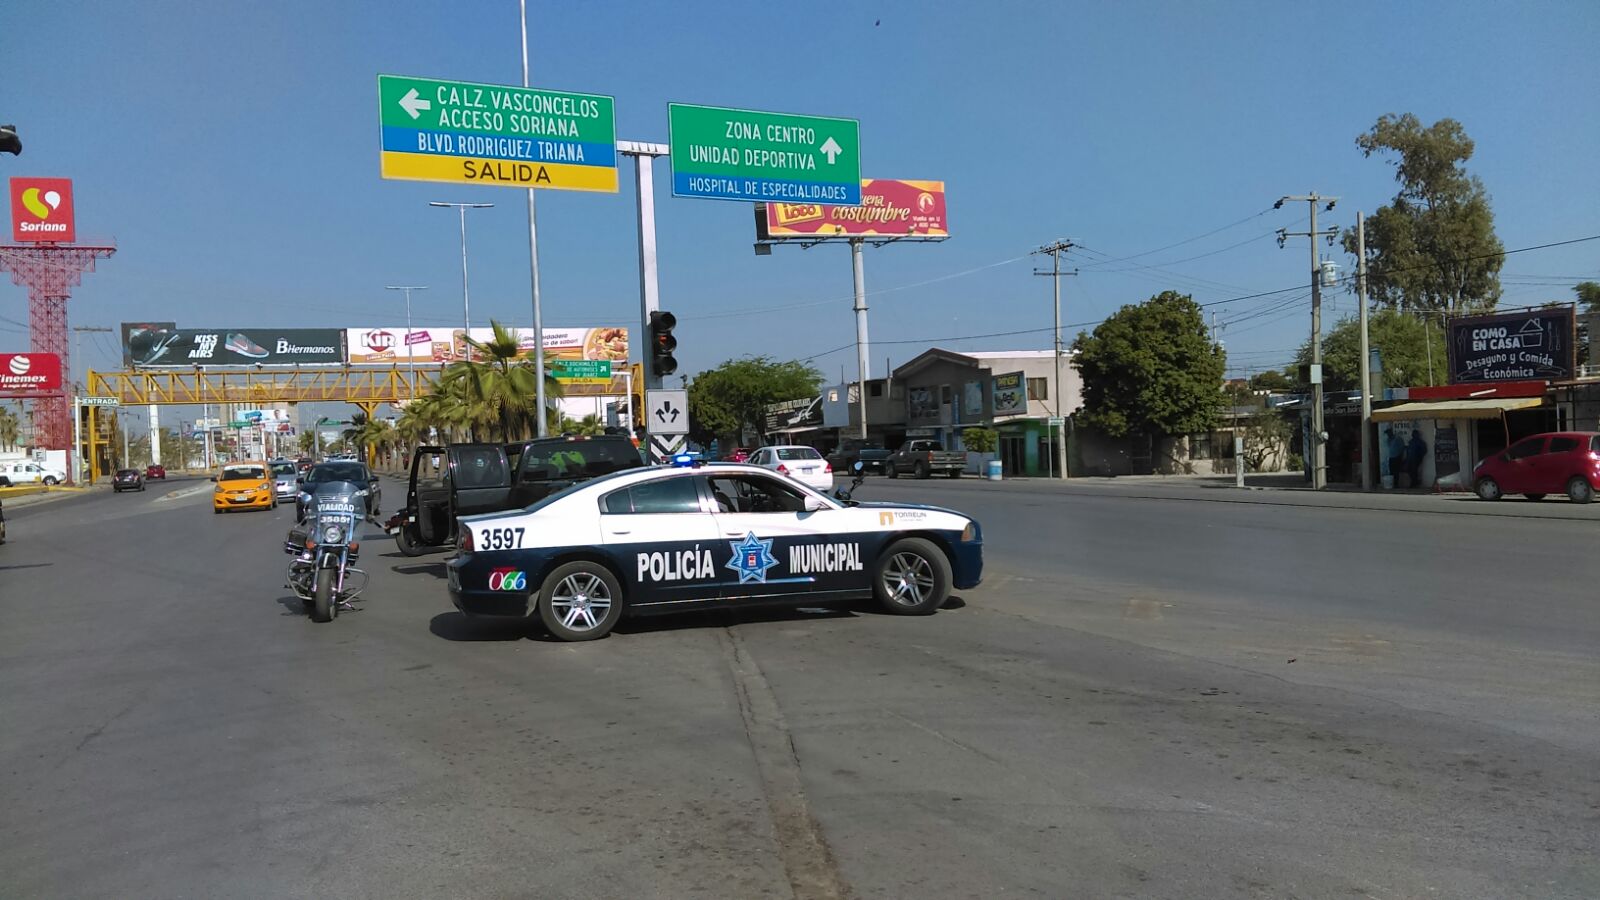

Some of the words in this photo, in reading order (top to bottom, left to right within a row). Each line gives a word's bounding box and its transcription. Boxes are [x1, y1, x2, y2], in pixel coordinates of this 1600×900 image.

[437, 86, 487, 109] CALZ.
[491, 91, 599, 118] VASCONCELOS
[438, 109, 503, 132] ACCESO
[510, 115, 579, 137] SORIANA
[724, 121, 761, 140] ZONA
[767, 125, 815, 144] CENTRO
[418, 132, 455, 154] BLVD.
[458, 135, 532, 159] RODRIGUEZ
[537, 141, 585, 162] TRIANA
[689, 144, 739, 166] UNIDAD
[745, 149, 816, 170] DEPORTIVA
[463, 160, 551, 184] SALIDA
[689, 177, 740, 194] HOSPITAL
[745, 181, 757, 196] DE
[762, 182, 847, 200] ESPECIALIDADES
[862, 195, 884, 206] uena
[785, 205, 817, 219] LOCO
[831, 201, 911, 223] costumbre
[20, 221, 67, 232] Soriana
[194, 334, 218, 343] KISS
[1472, 327, 1507, 340] COMO
[200, 342, 217, 351] MY
[1472, 340, 1487, 351] EN
[1489, 337, 1521, 350] CASA
[188, 350, 214, 358] AIRS
[1466, 352, 1507, 370] Desayuno
[1509, 353, 1516, 364] y
[1519, 351, 1553, 366] Comida
[0, 374, 47, 383] inemex
[1483, 366, 1534, 379] Económica
[83, 397, 118, 405] ENTRADA
[318, 503, 354, 511] VIALIDAD
[481, 527, 525, 550] 3597
[637, 543, 715, 582] POLICÍA
[789, 543, 863, 574] MUNICIPAL
[488, 570, 526, 590] 066
